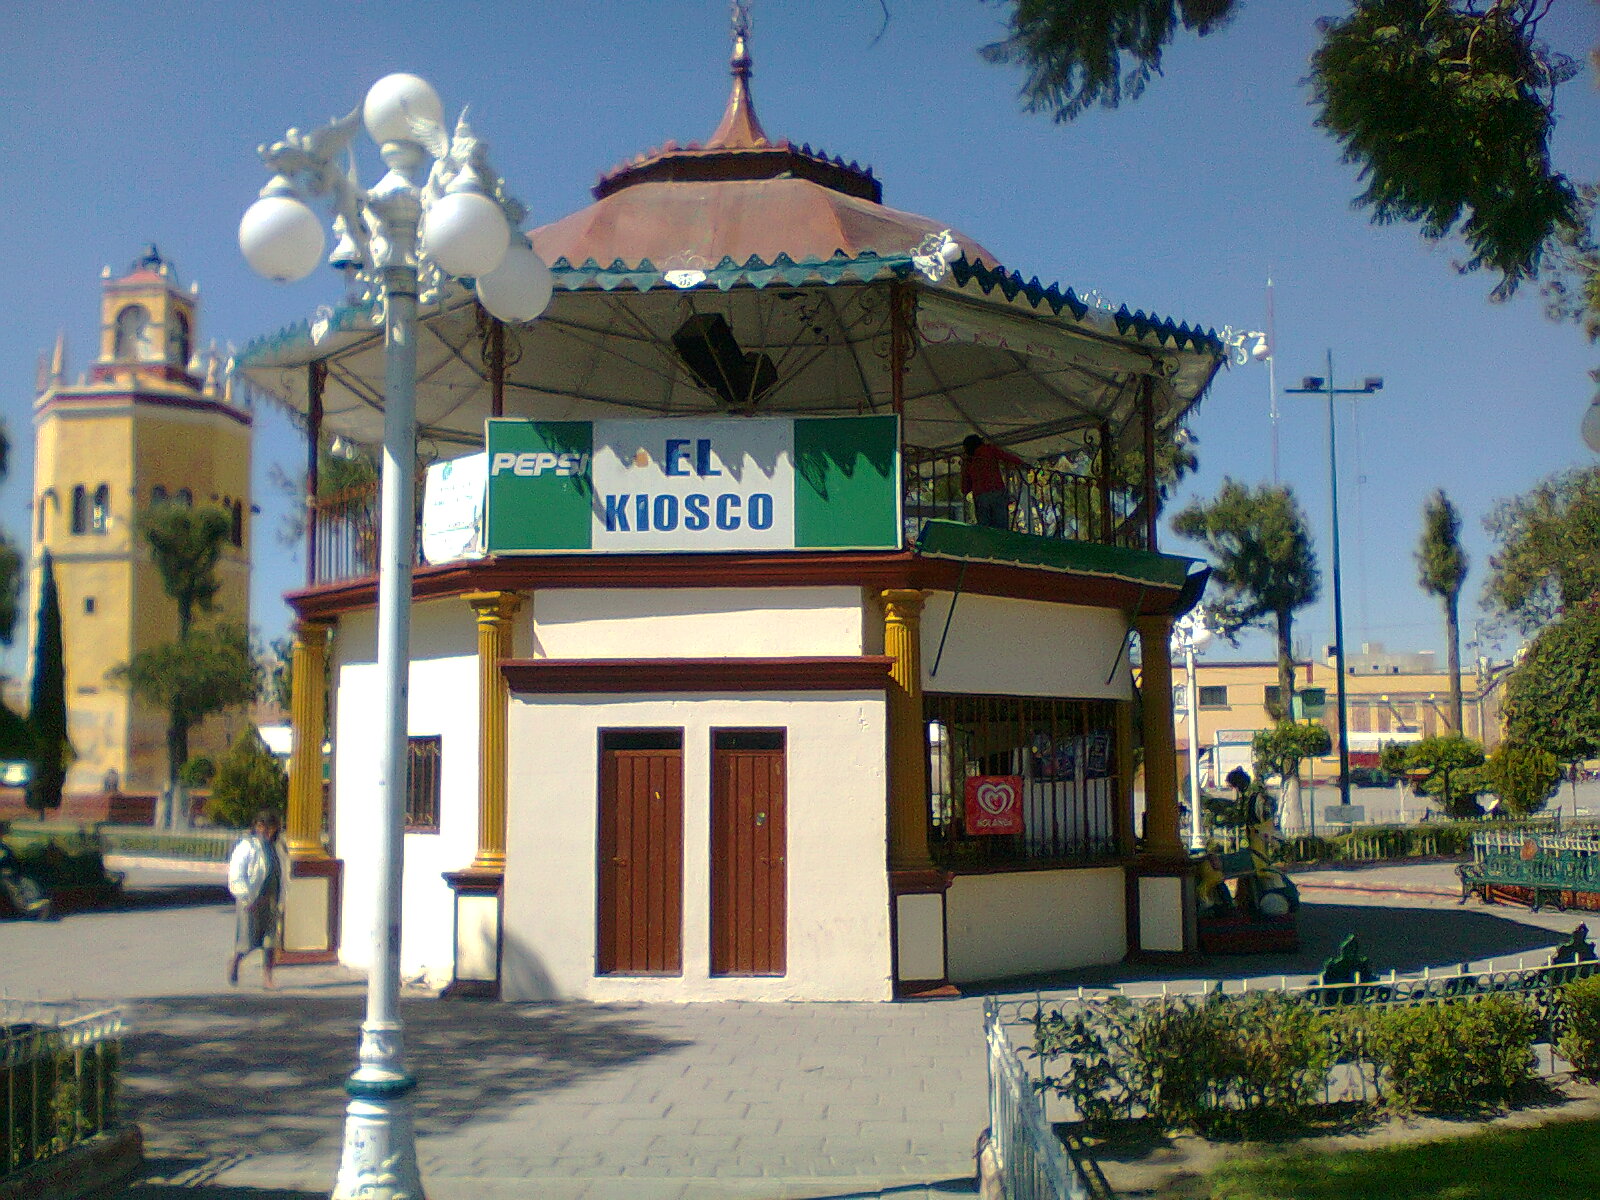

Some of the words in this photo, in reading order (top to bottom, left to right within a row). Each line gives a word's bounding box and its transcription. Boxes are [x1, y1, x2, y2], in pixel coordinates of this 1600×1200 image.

[491, 452, 589, 476] PEPSI
[665, 439, 722, 476] EL
[605, 493, 773, 532] KIOSCO
